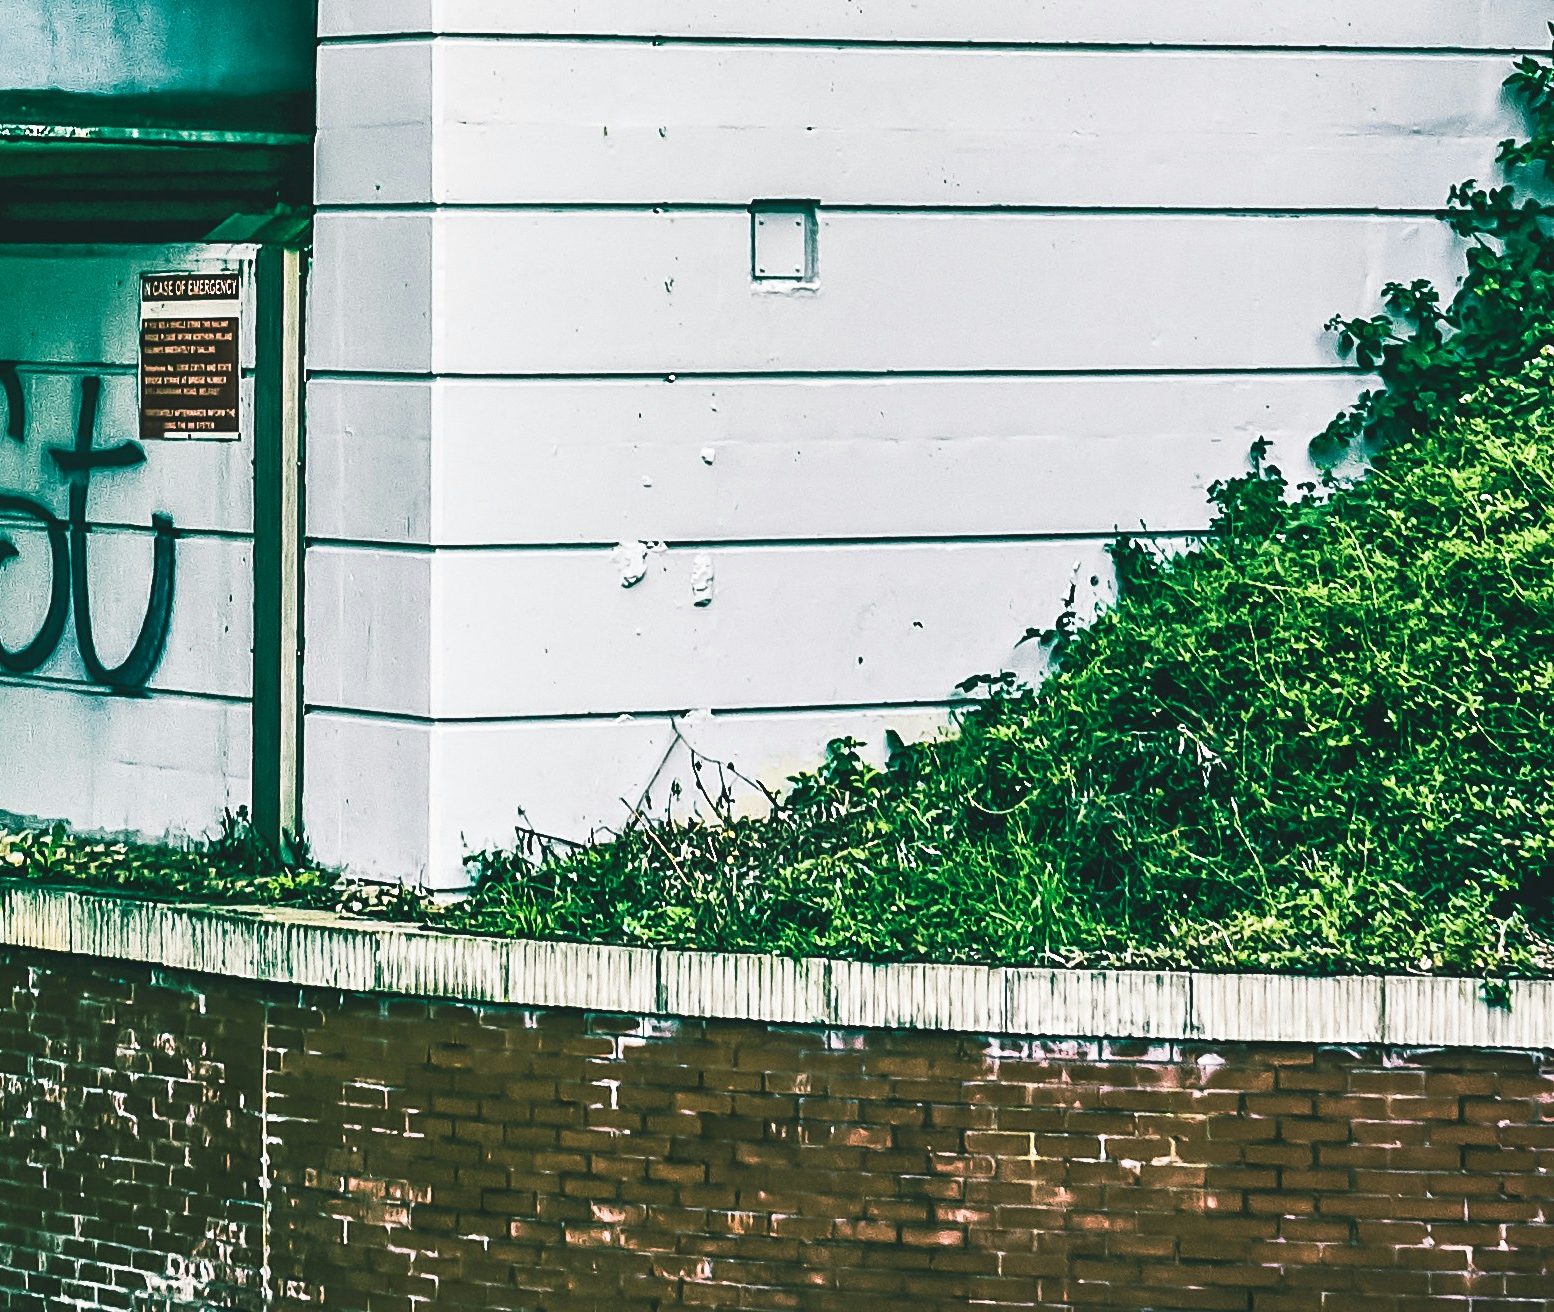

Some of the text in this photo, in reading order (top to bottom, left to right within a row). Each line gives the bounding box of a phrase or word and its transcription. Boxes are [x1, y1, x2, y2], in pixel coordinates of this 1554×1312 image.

[152, 280, 174, 296] CASE
[175, 280, 186, 295] OF
[188, 279, 237, 295] EMERGENCY
